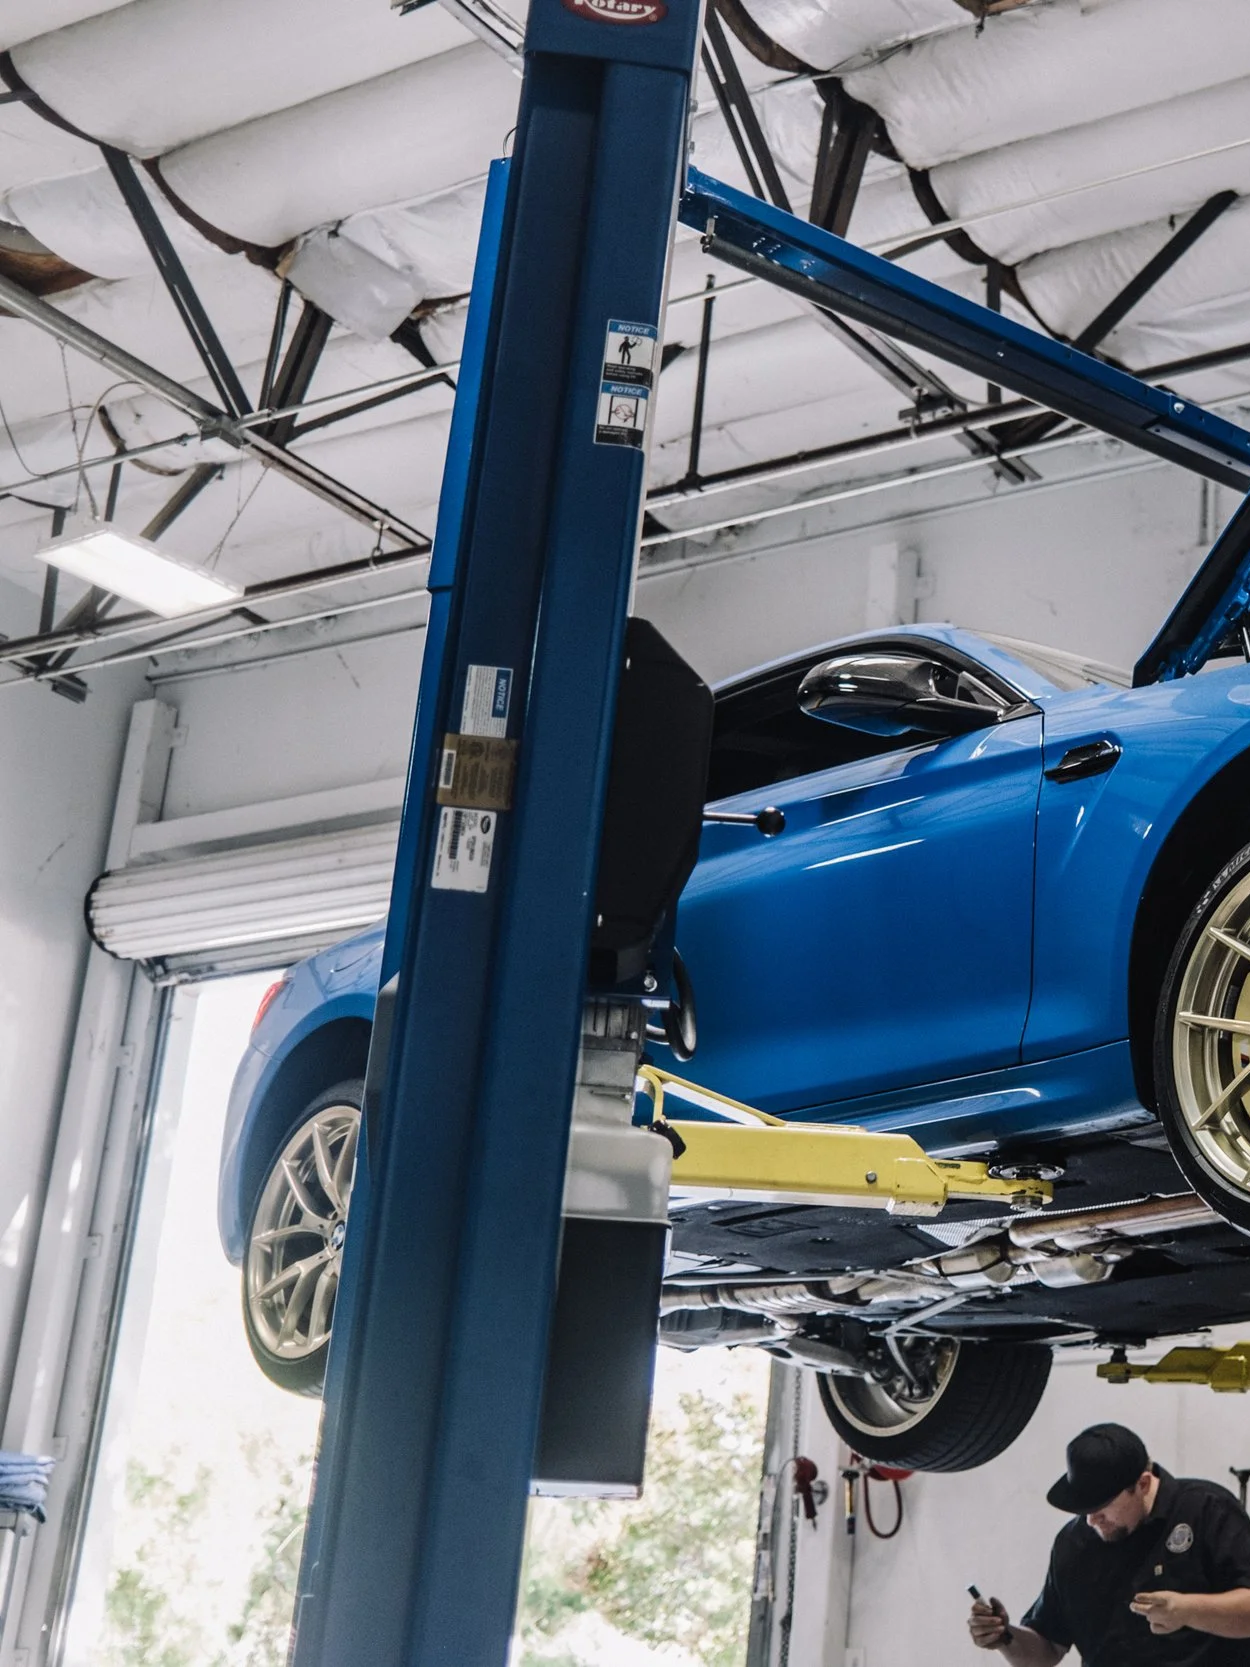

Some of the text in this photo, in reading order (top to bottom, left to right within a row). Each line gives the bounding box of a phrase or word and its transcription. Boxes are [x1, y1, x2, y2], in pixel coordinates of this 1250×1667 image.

[574, 0, 656, 15] otary
[617, 324, 650, 335] NOTICE
[610, 384, 642, 396] NOTICE
[496, 678, 507, 711] NOTICE
